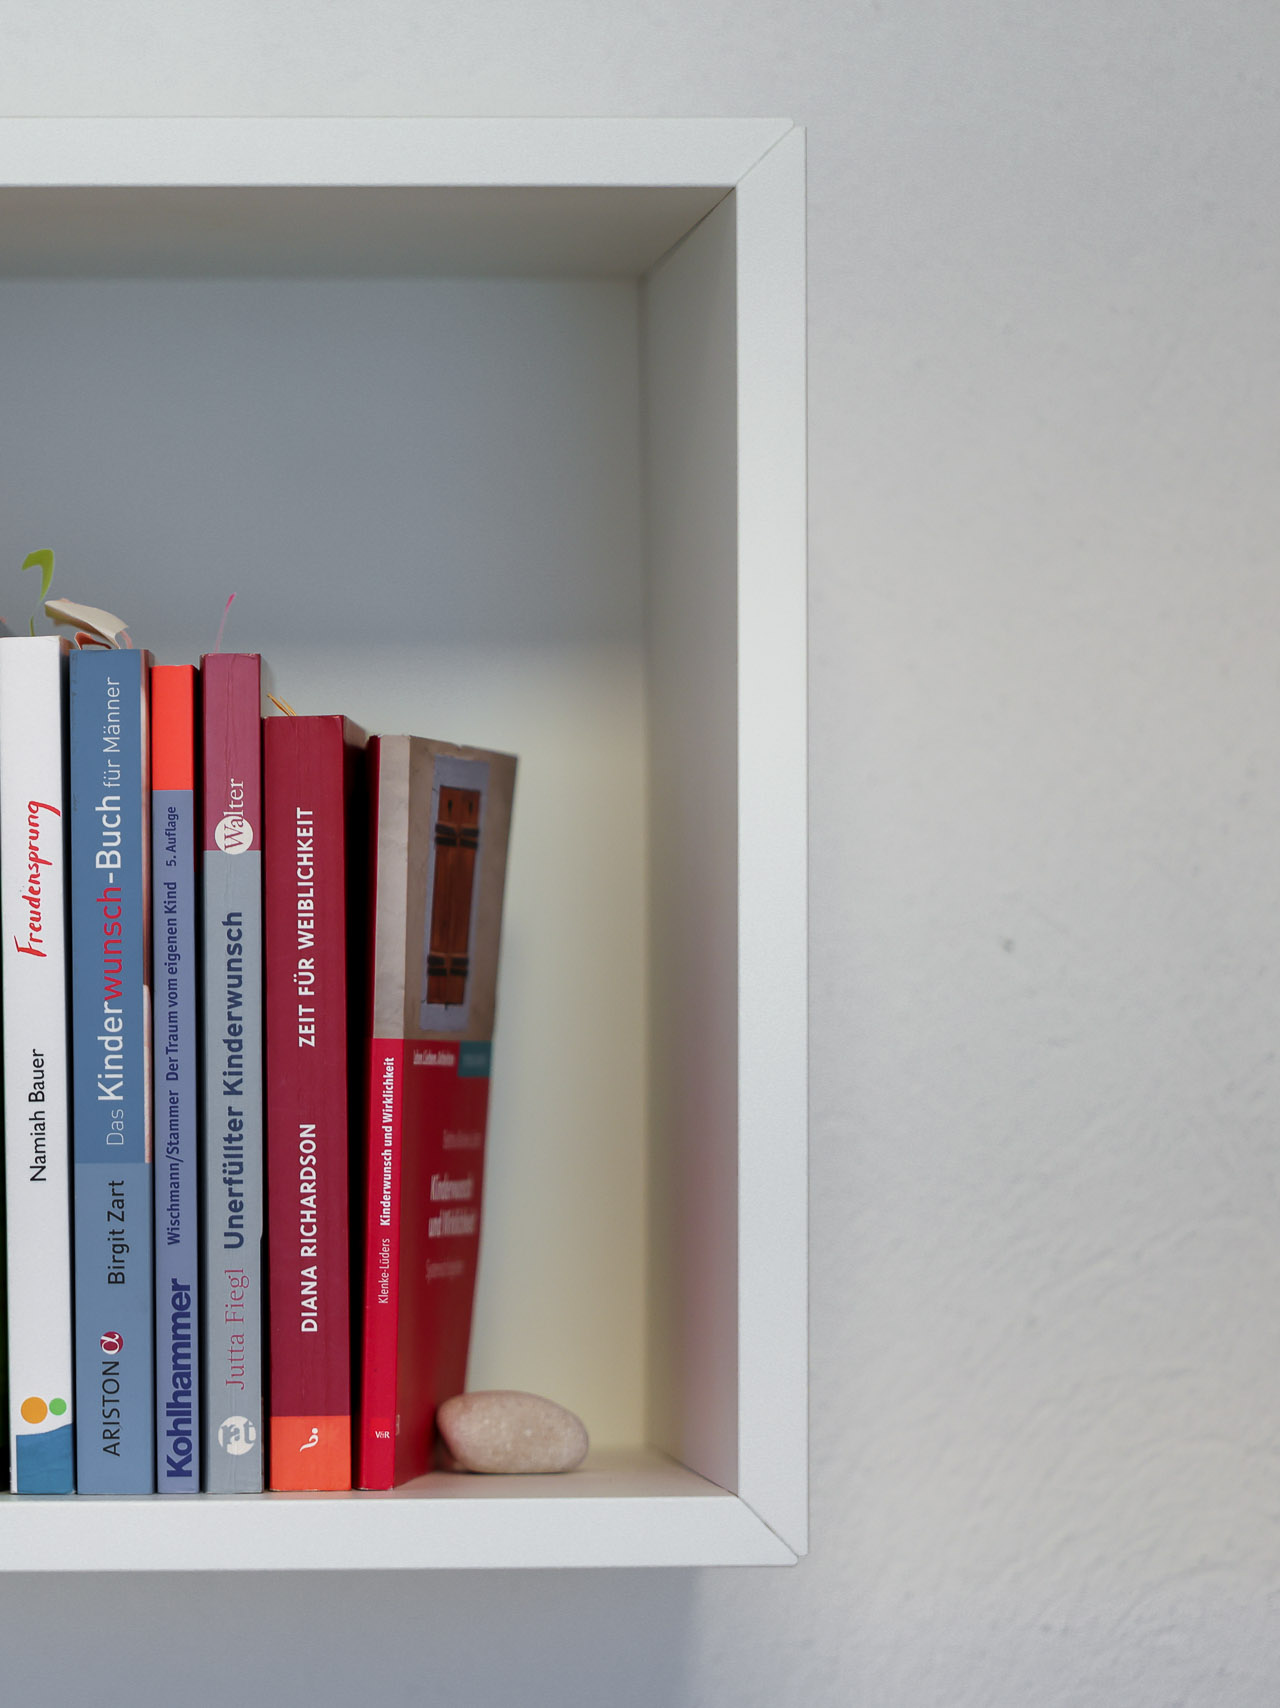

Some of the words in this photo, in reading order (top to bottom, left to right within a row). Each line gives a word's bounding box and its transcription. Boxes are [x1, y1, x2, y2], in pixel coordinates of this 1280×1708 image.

[102, 676, 121, 753] Männer
[102, 763, 121, 788] für
[164, 806, 179, 853] Auflage
[223, 777, 244, 850] Walter
[13, 800, 61, 958] Freudensprung
[165, 854, 177, 867] 5.
[296, 806, 315, 950] WEIBLICHKEIT
[163, 881, 178, 914] Kind
[95, 795, 124, 1101] Kinderwunsch-Buch
[164, 918, 181, 976] eigenen
[167, 979, 179, 1007] vom
[221, 911, 243, 1096] Kinderwunsch
[293, 957, 315, 996] FÜR
[165, 1011, 179, 1055] Traum
[297, 1004, 316, 1048] ZEIT
[28, 1048, 45, 1103] Bauer
[165, 1056, 179, 1081] Der
[381, 1057, 395, 1123] Wirklichkeit
[28, 1110, 47, 1182] Namiah
[106, 1108, 125, 1145] Das
[381, 1125, 393, 1147] und
[166, 1089, 184, 1245] Wischmann/Stammer
[222, 1105, 244, 1250] Unerfüllter
[298, 1123, 318, 1258] RICHARDSON
[379, 1149, 393, 1227] Kinderwunsch
[107, 1180, 125, 1222] Zart
[107, 1228, 130, 1285] Birgit
[377, 1237, 391, 1304] Klenke-Lüders
[224, 1267, 250, 1323] Fiegl
[300, 1265, 318, 1333] DIANA
[166, 1277, 193, 1478] Kohlhammer
[224, 1333, 245, 1391] Jutta
[102, 1360, 121, 1457] ARISTON
[375, 1430, 390, 1439] V&R
